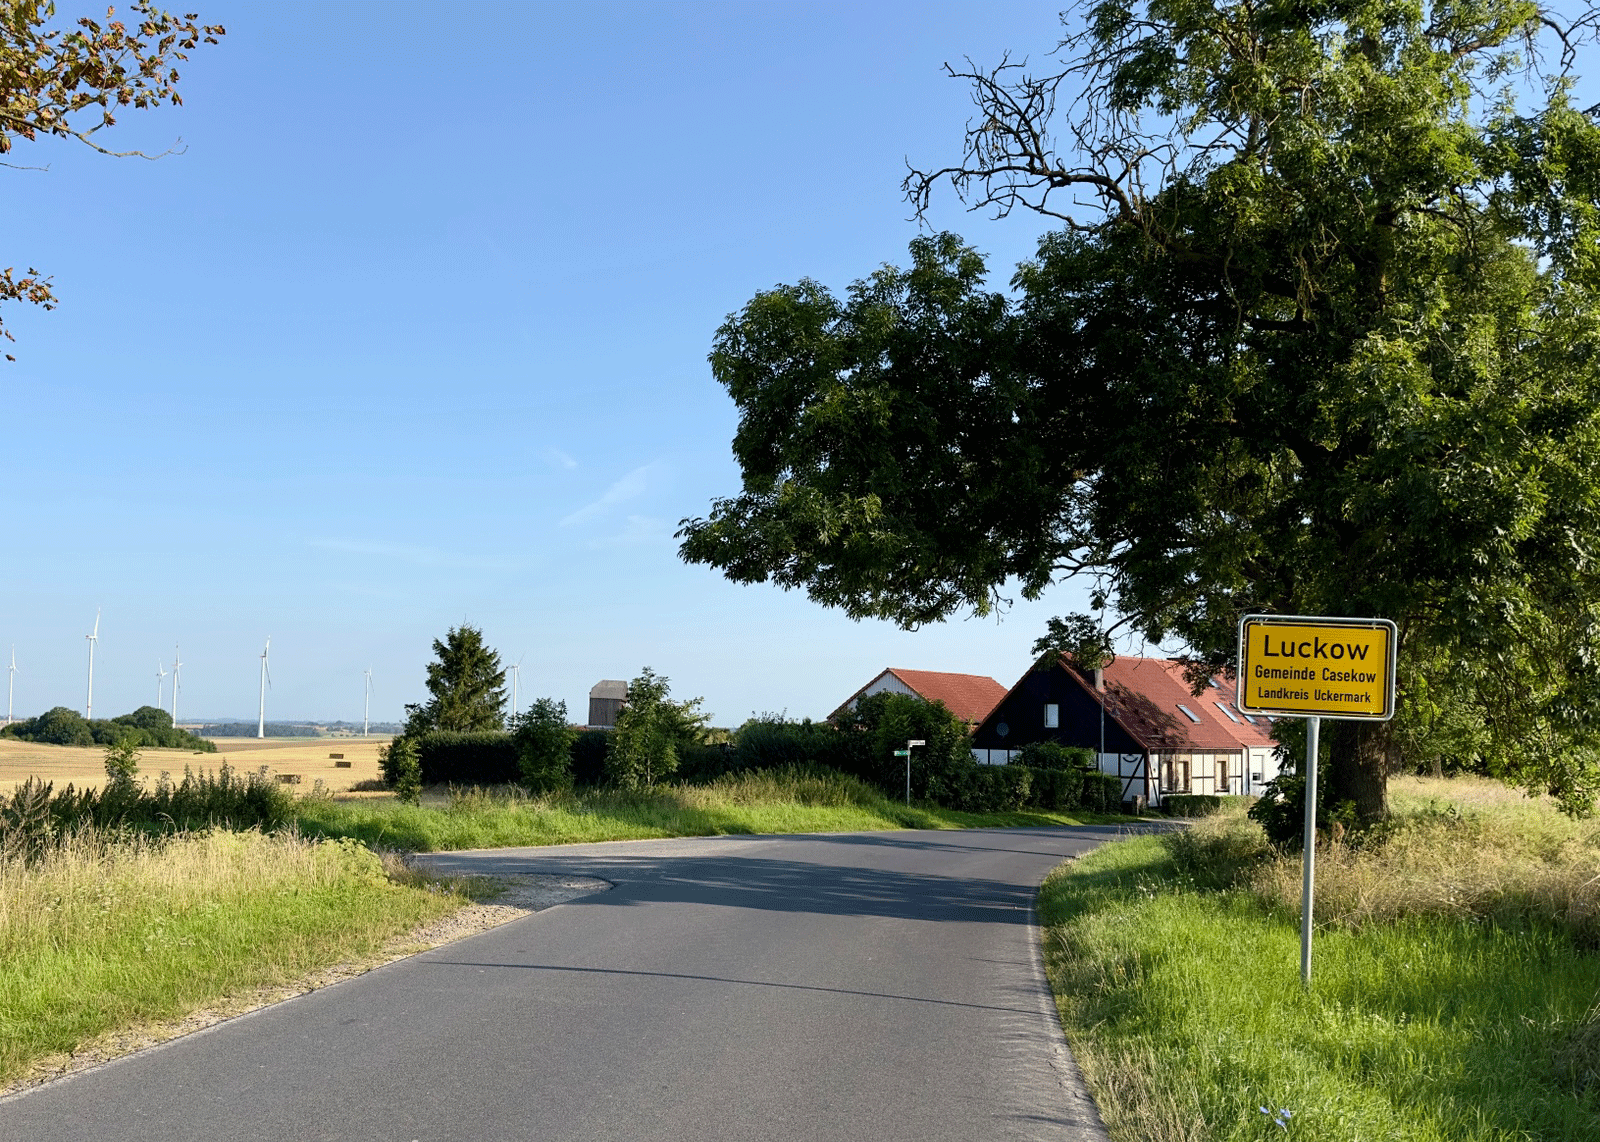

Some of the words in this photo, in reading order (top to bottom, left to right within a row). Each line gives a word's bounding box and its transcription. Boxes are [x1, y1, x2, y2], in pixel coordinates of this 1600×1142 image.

[1264, 634, 1370, 661] Luckow
[1255, 664, 1316, 681] Gemeinde
[1322, 667, 1377, 683] Casekow
[1258, 686, 1309, 700] Landkreis
[1314, 689, 1371, 703] Uckermark
